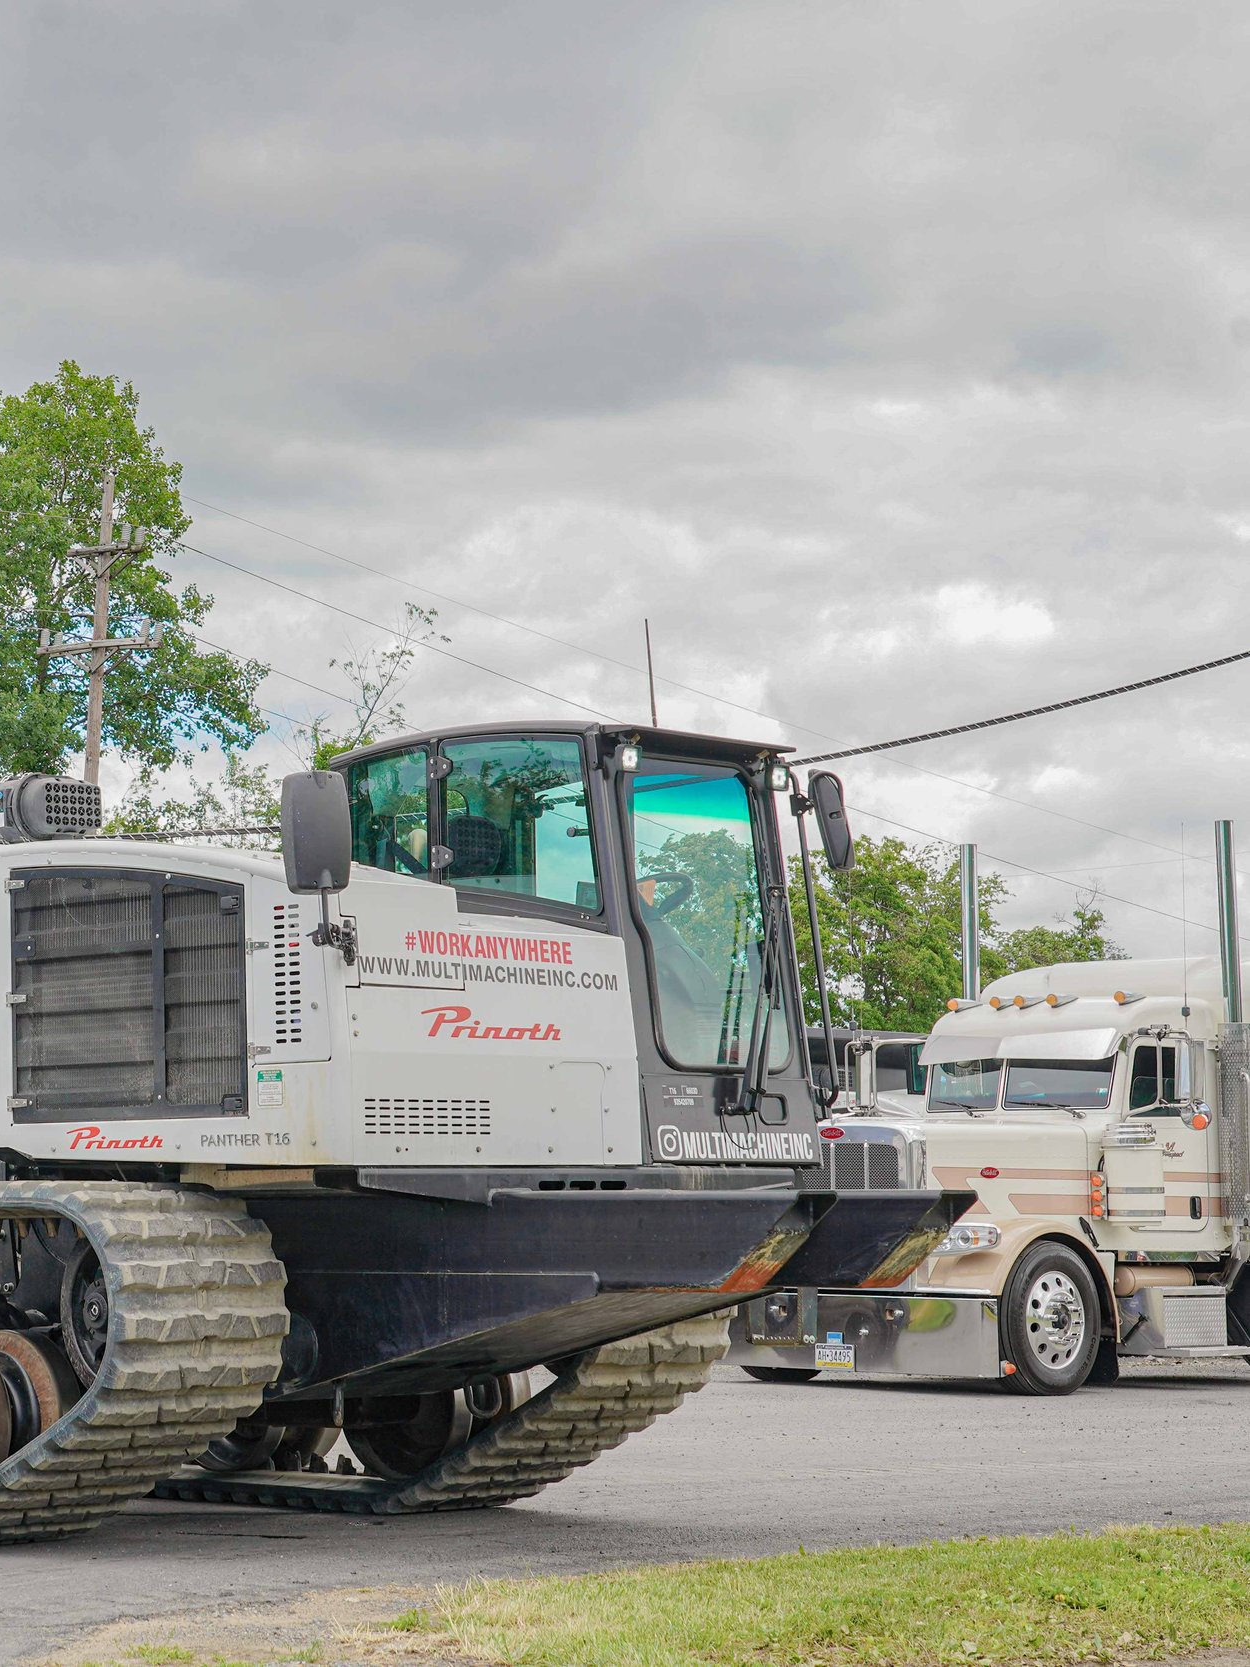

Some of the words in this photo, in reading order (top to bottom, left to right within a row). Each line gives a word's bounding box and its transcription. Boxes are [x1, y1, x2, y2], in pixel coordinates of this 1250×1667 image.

[405, 930, 573, 965] #WORKANYWHERE
[357, 955, 618, 991] WWW.MULTIMACHINEINC.COM
[421, 1006, 561, 1041] Prinoth
[66, 1126, 163, 1150] Prinoth
[200, 1133, 261, 1148] PANTHER
[265, 1132, 291, 1146] T16
[682, 1131, 813, 1160] MULTIMACHINEINC
